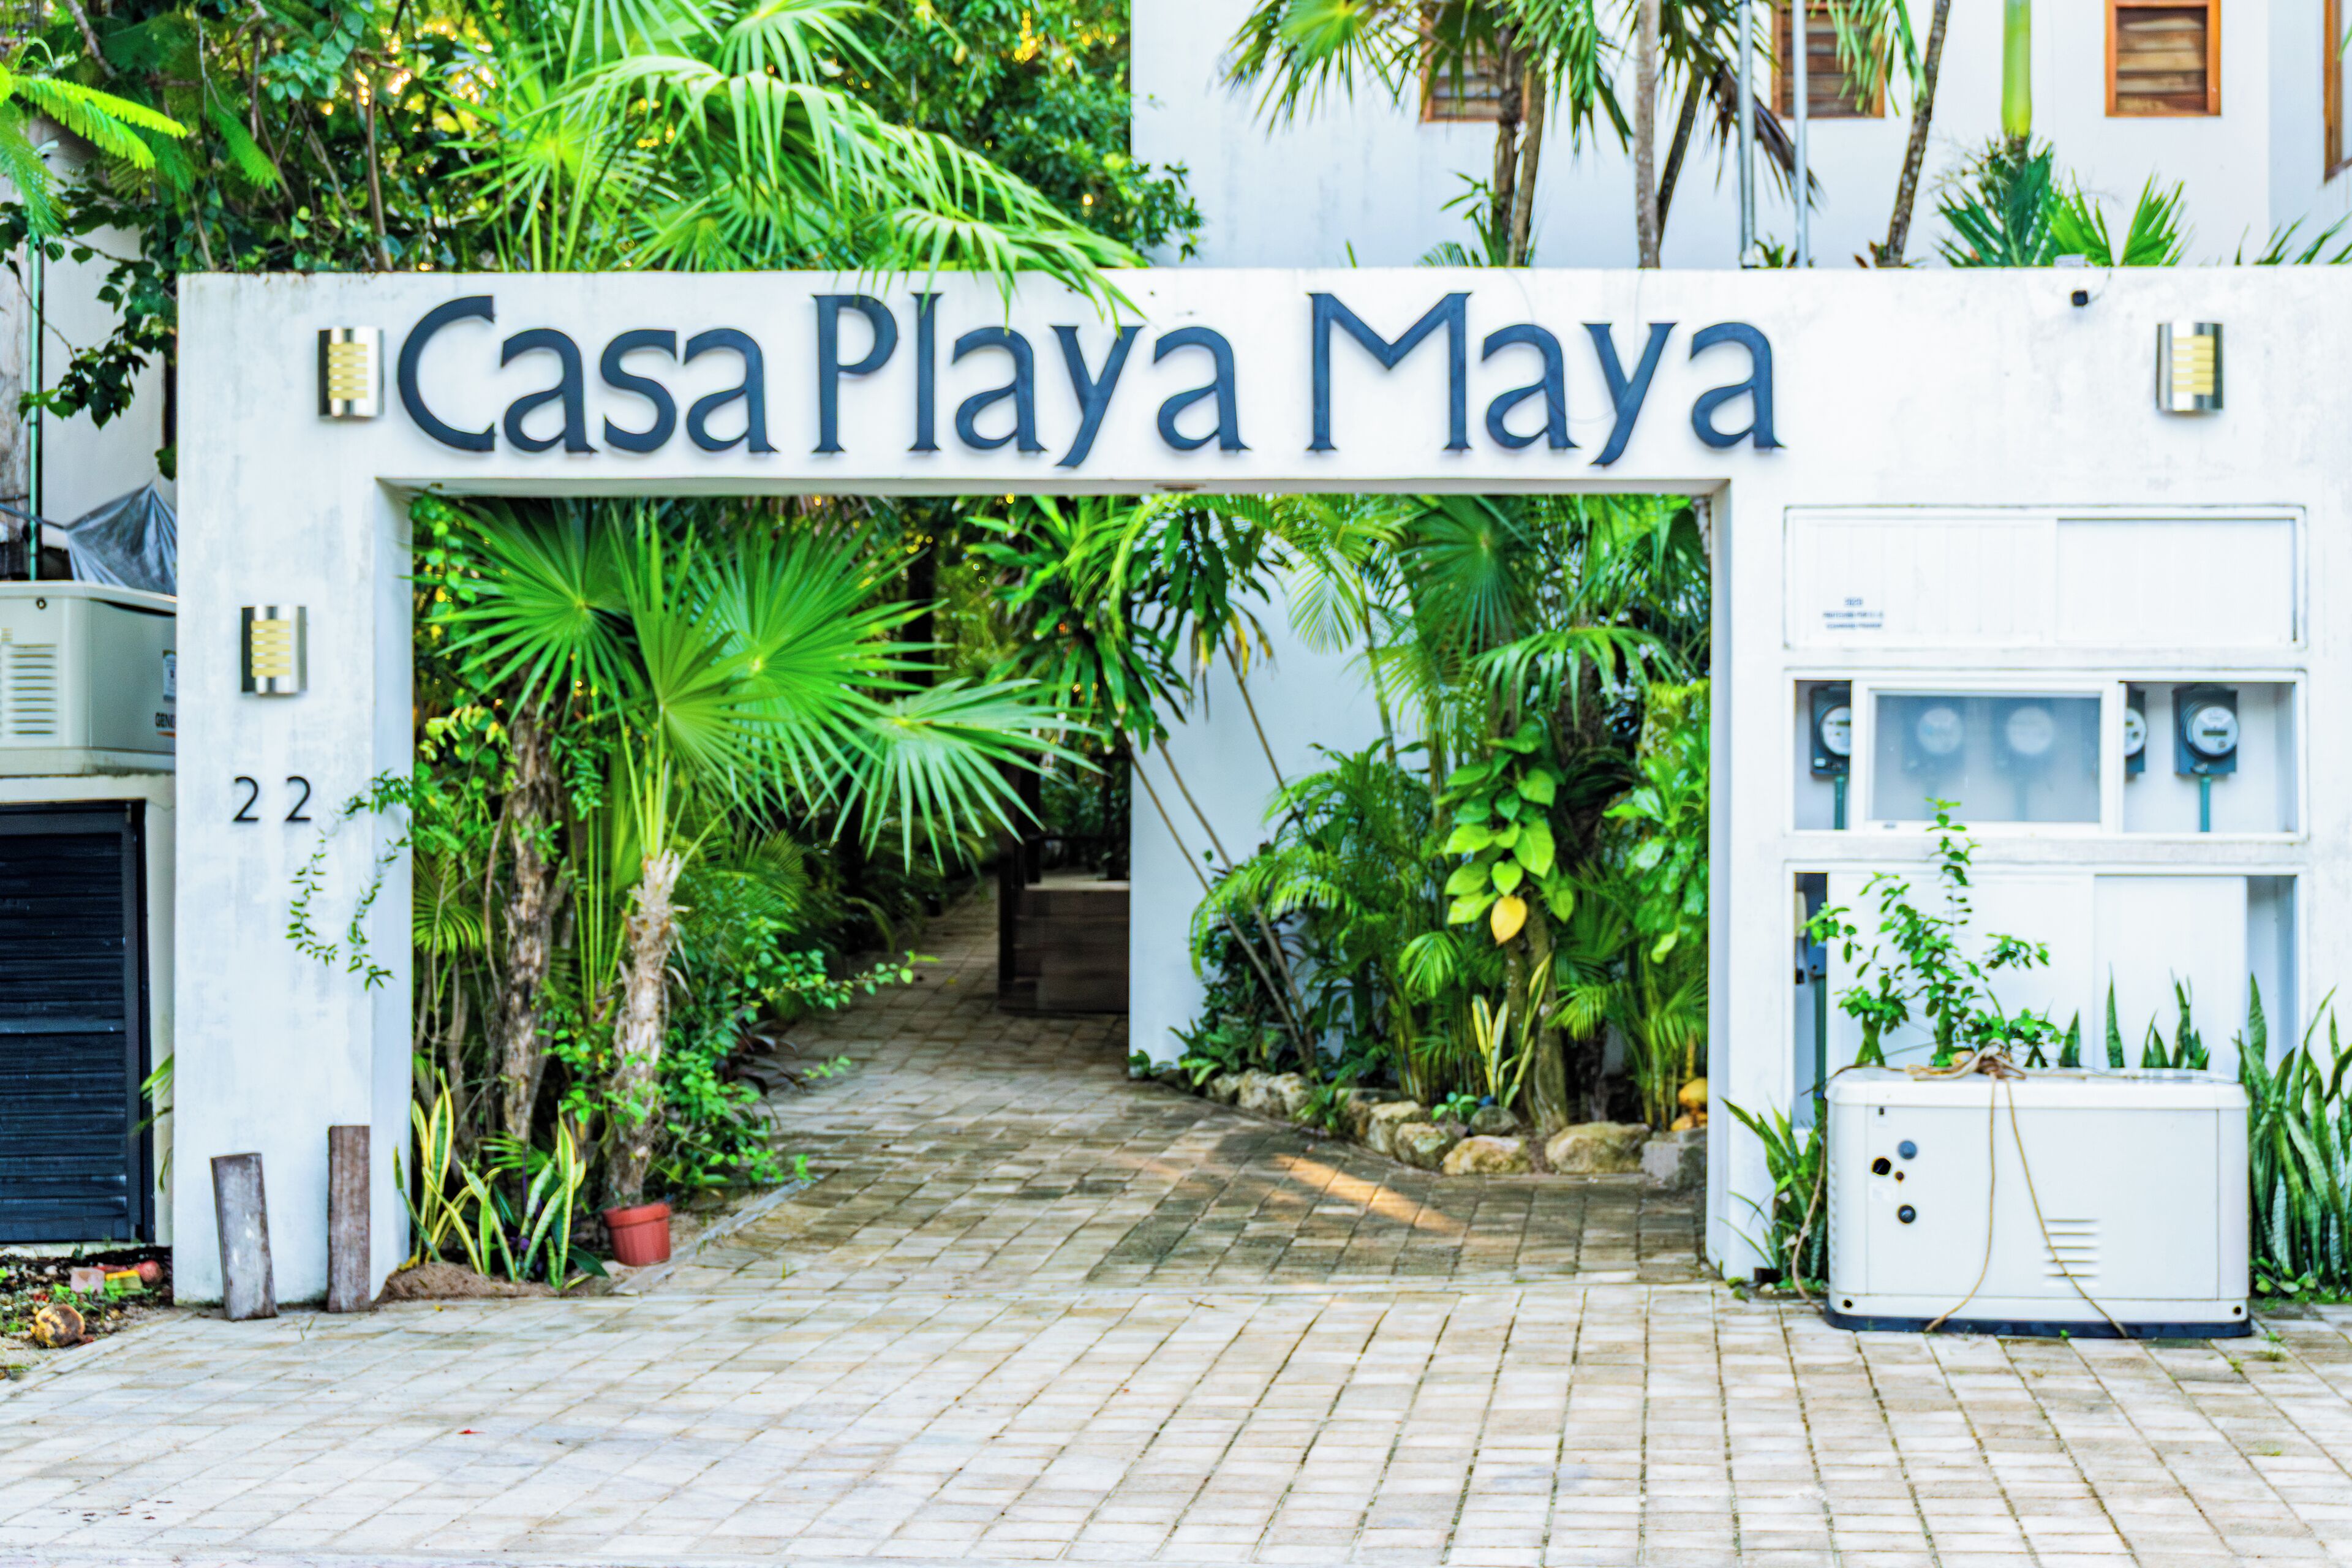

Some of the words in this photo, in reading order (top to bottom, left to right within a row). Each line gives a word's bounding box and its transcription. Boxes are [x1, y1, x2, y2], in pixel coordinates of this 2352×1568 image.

[397, 295, 780, 454] Casa
[812, 292, 1251, 468] Playa
[1306, 292, 1786, 467] Maya
[232, 775, 312, 823] 22
